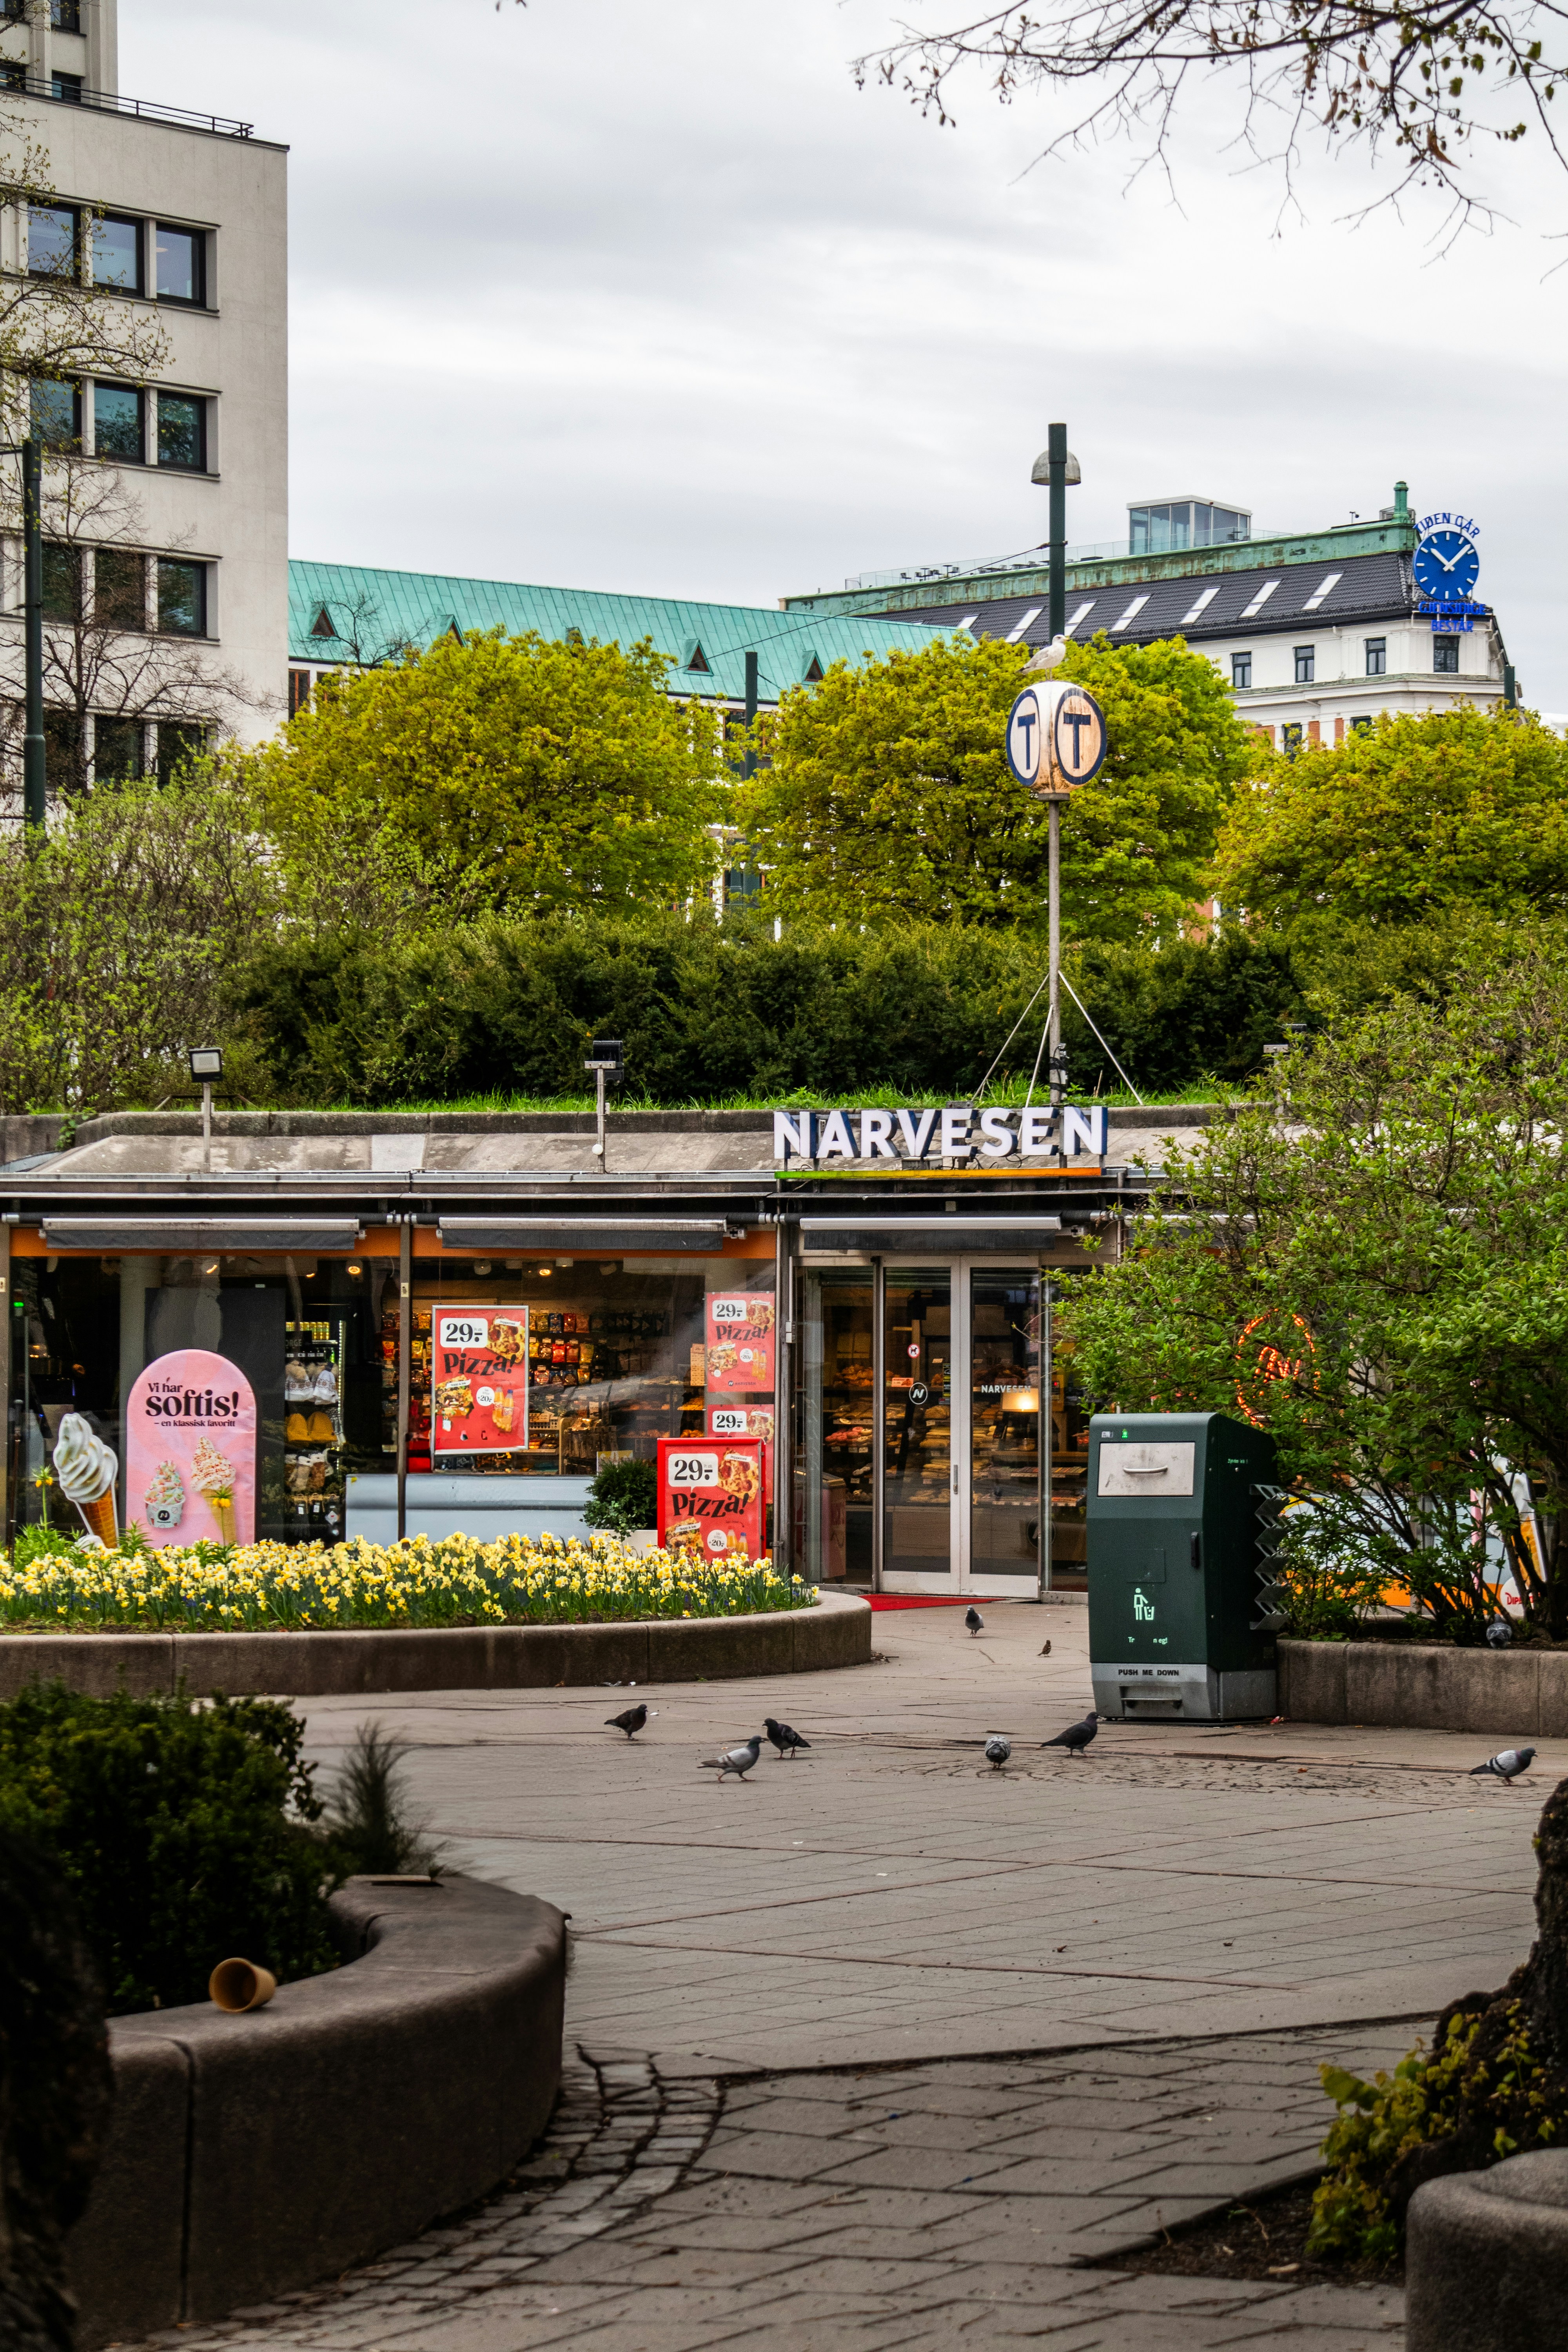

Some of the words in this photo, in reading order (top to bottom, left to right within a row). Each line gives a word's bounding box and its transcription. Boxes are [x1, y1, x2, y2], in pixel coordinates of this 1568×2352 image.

[1413, 513, 1450, 534] TIDEN
[1455, 515, 1480, 539] GÅR
[1418, 601, 1486, 615] GJENSIDIGE
[1431, 617, 1474, 632] BESTÅR
[1017, 713, 1036, 770] T
[1063, 712, 1091, 769] T
[774, 1107, 1108, 1159] NARVESEN
[715, 1325, 768, 1341] Pizza!
[443, 1353, 517, 1376] Pizza!
[148, 1383, 159, 1392] Vi
[162, 1383, 183, 1392] har
[145, 1389, 239, 1417] softis!
[671, 1492, 749, 1518] Pizza!
